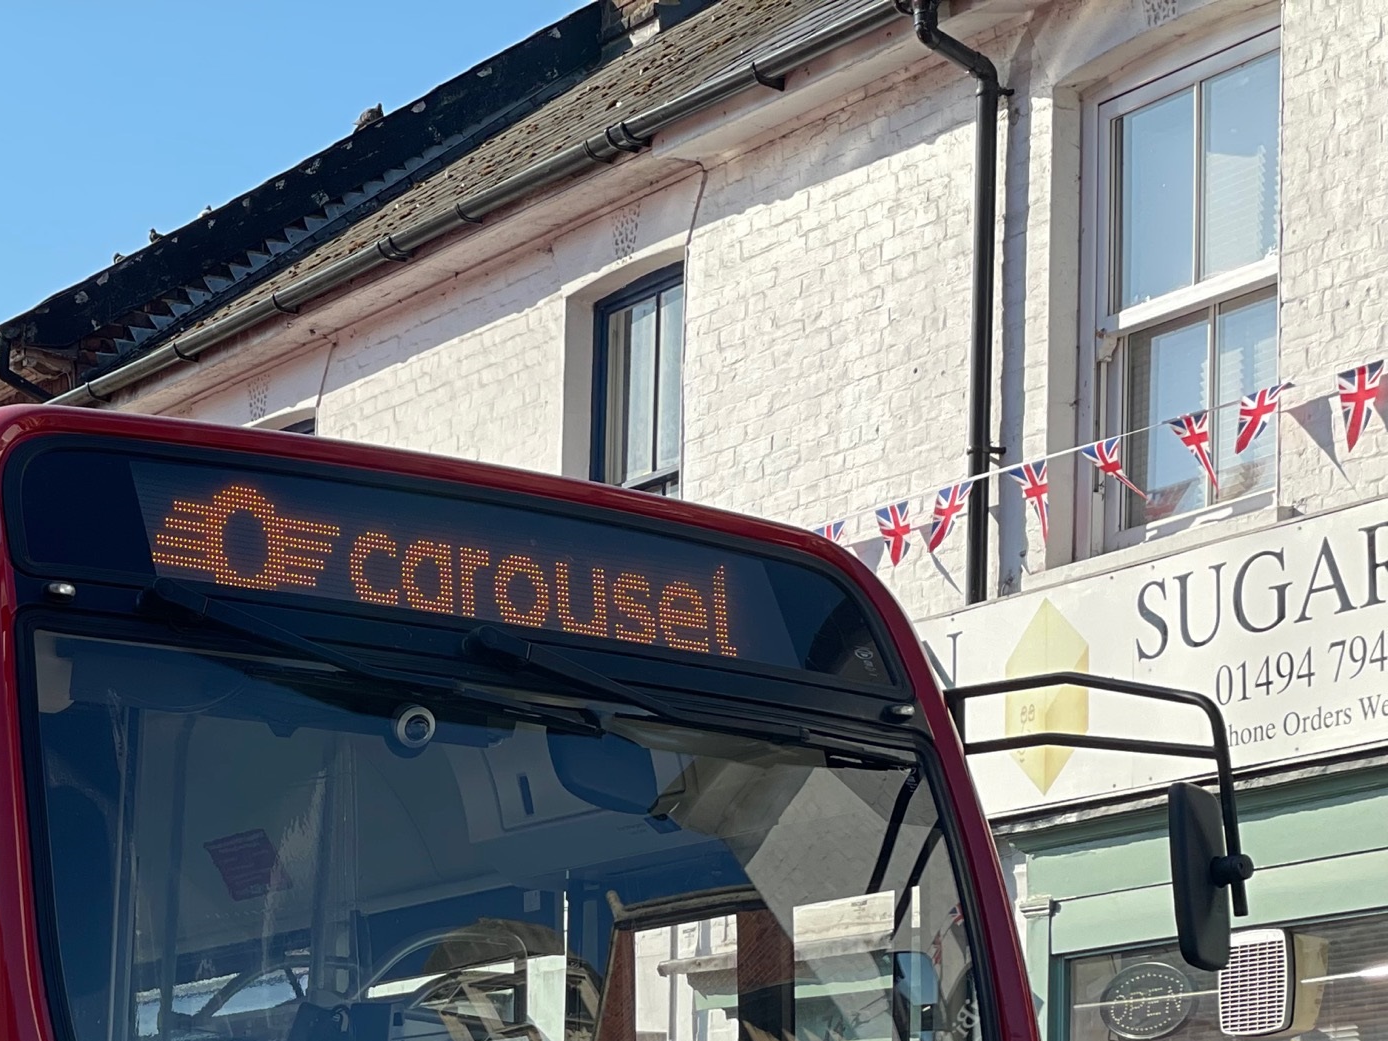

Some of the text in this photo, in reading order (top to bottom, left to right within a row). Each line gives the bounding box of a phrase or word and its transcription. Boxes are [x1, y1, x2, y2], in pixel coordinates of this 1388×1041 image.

[350, 530, 738, 658] carousel
[1216, 646, 1315, 706] 01494
[1226, 722, 1277, 747] hone
[1283, 706, 1352, 737] Orders
